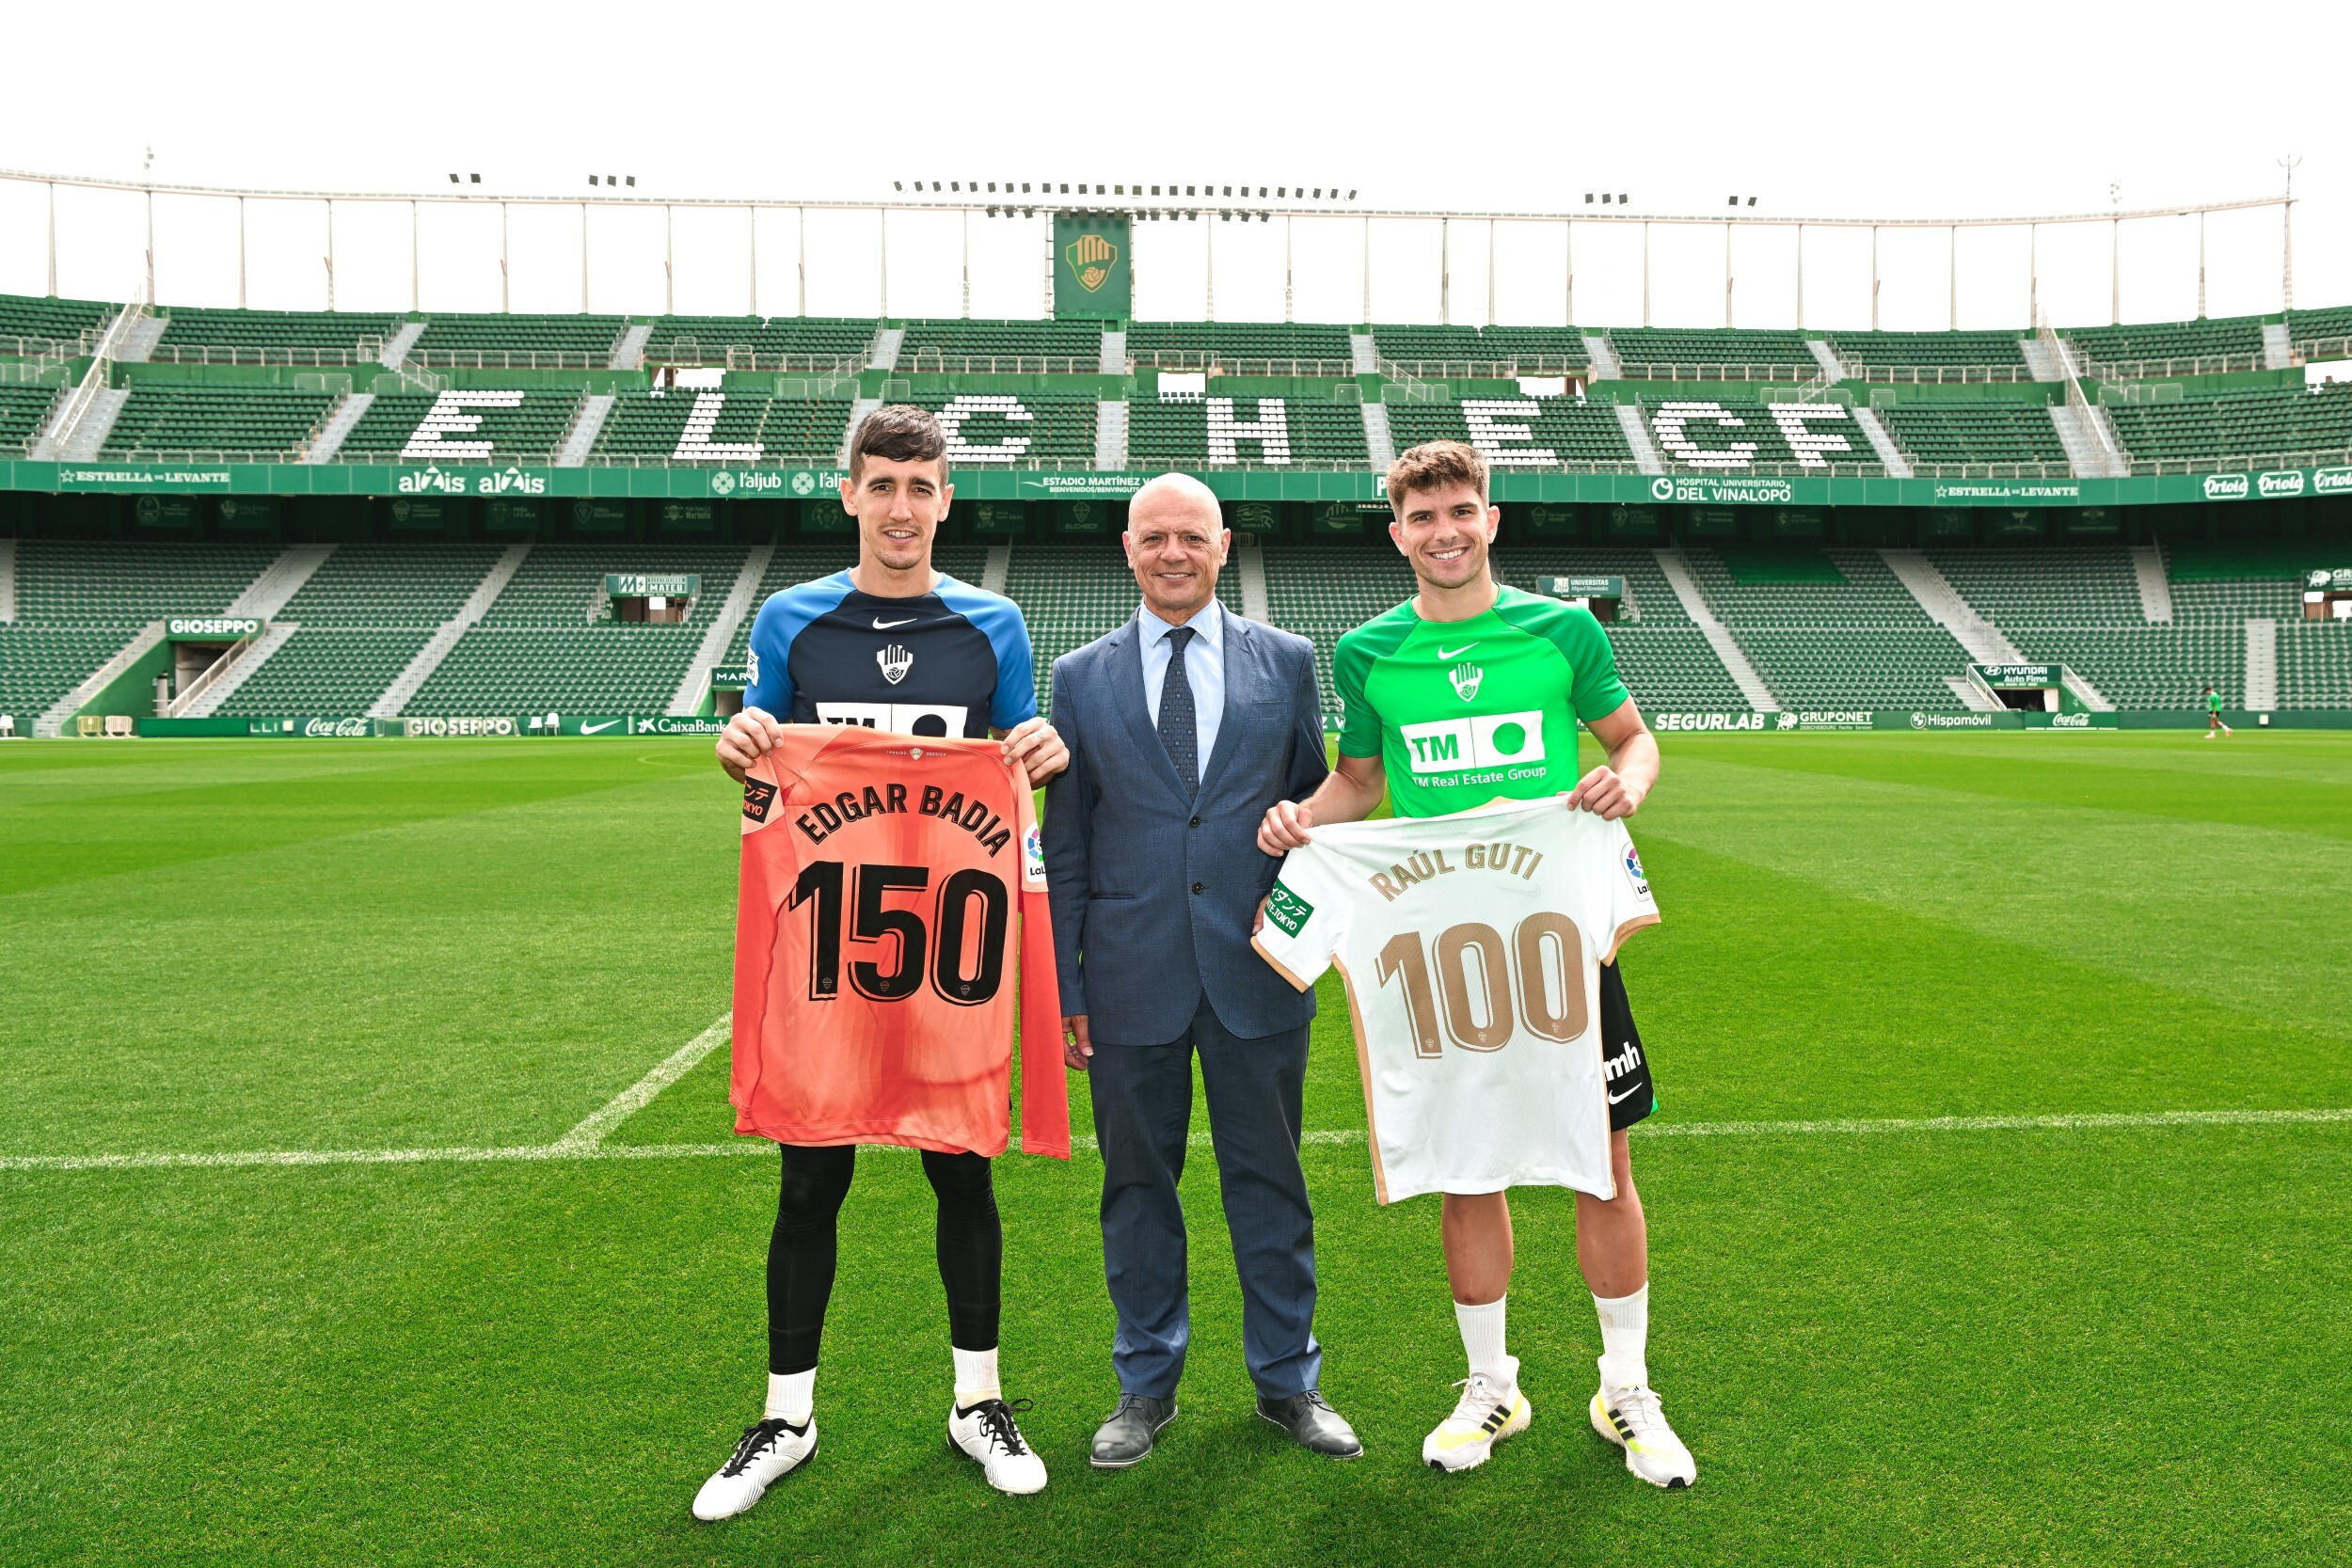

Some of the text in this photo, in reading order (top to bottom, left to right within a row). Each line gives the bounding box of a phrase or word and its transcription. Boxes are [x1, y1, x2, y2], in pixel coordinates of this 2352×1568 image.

[76, 471, 153, 483] ESTRELLA
[165, 472, 230, 483] LEVANTE
[819, 472, 842, 491] l'alj
[1043, 477, 1086, 486] ESTADIO
[1089, 475, 1140, 486] MARTÍNEZ
[1677, 478, 1786, 487] HOSPITAL UNIVERSITARIO
[1677, 487, 1708, 500] DEL
[1948, 486, 2010, 497] ESTRELLA
[2020, 486, 2078, 497] LEVANTE
[170, 620, 258, 633] GIOSEPPO
[716, 673, 747, 681] MAR
[2004, 666, 2048, 675] HYUNDAI
[1655, 713, 1765, 731] SEGURLAB
[1800, 711, 1873, 722] GRUPONET
[1928, 713, 1992, 727] Hispamóvil
[306, 717, 369, 736] Coca-Cola
[409, 719, 512, 736] GIOSEPPO
[659, 719, 725, 733] CaixaBank
[1411, 734, 1459, 763] TM
[1412, 767, 1547, 787] TM Real Estate Group
[796, 783, 1011, 858] EDGAR BADIA
[1029, 865, 1046, 876] LaL
[1368, 843, 1544, 901] RAÚL GUTI
[788, 860, 1009, 1006] 150
[1375, 911, 1589, 1060] 100
[1603, 1040, 1642, 1082] mh
